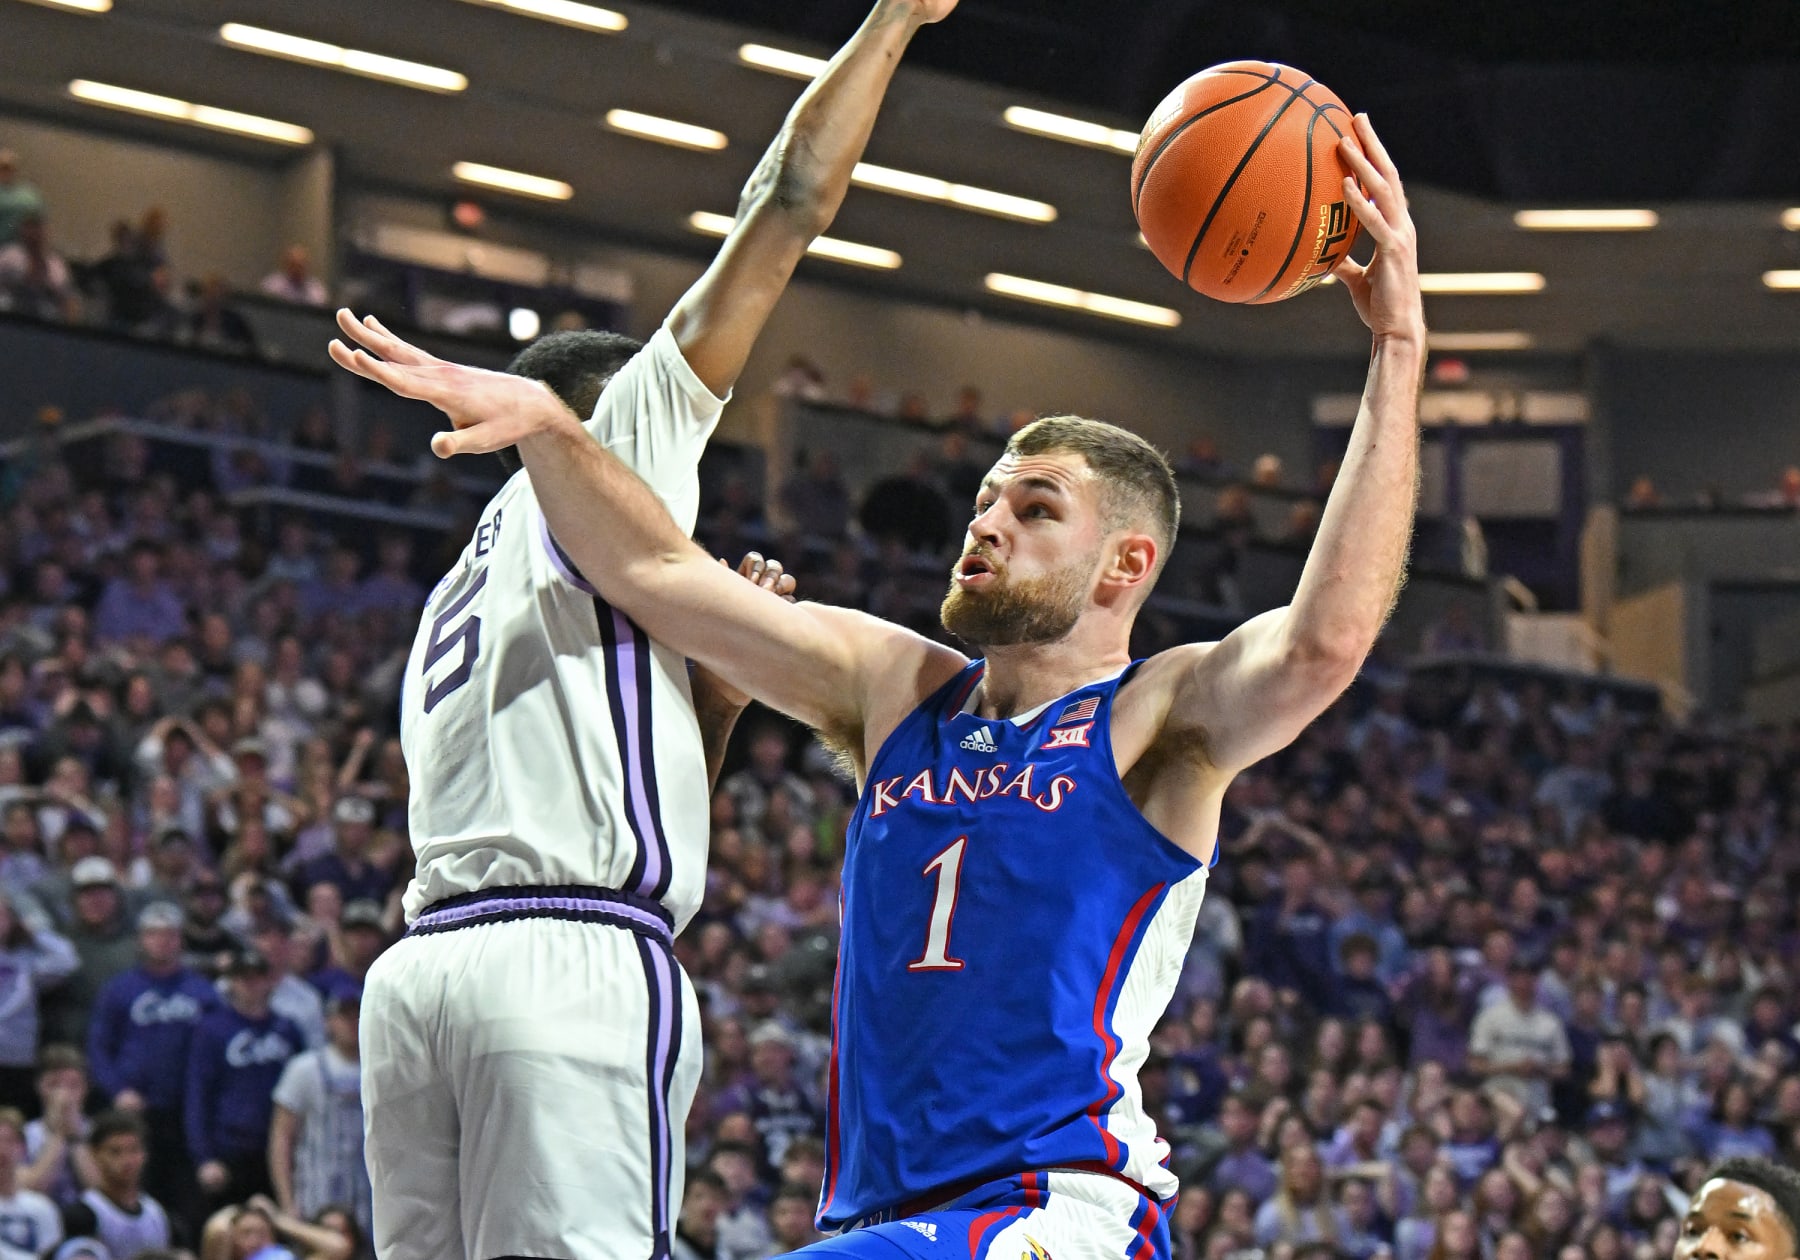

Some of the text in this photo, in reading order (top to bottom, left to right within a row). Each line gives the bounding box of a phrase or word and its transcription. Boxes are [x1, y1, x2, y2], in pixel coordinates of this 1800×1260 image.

[422, 566, 488, 714] 5
[960, 740, 998, 753] adidas
[1041, 721, 1095, 749] XII
[871, 762, 1076, 817] KANSAS
[908, 834, 968, 971] 1
